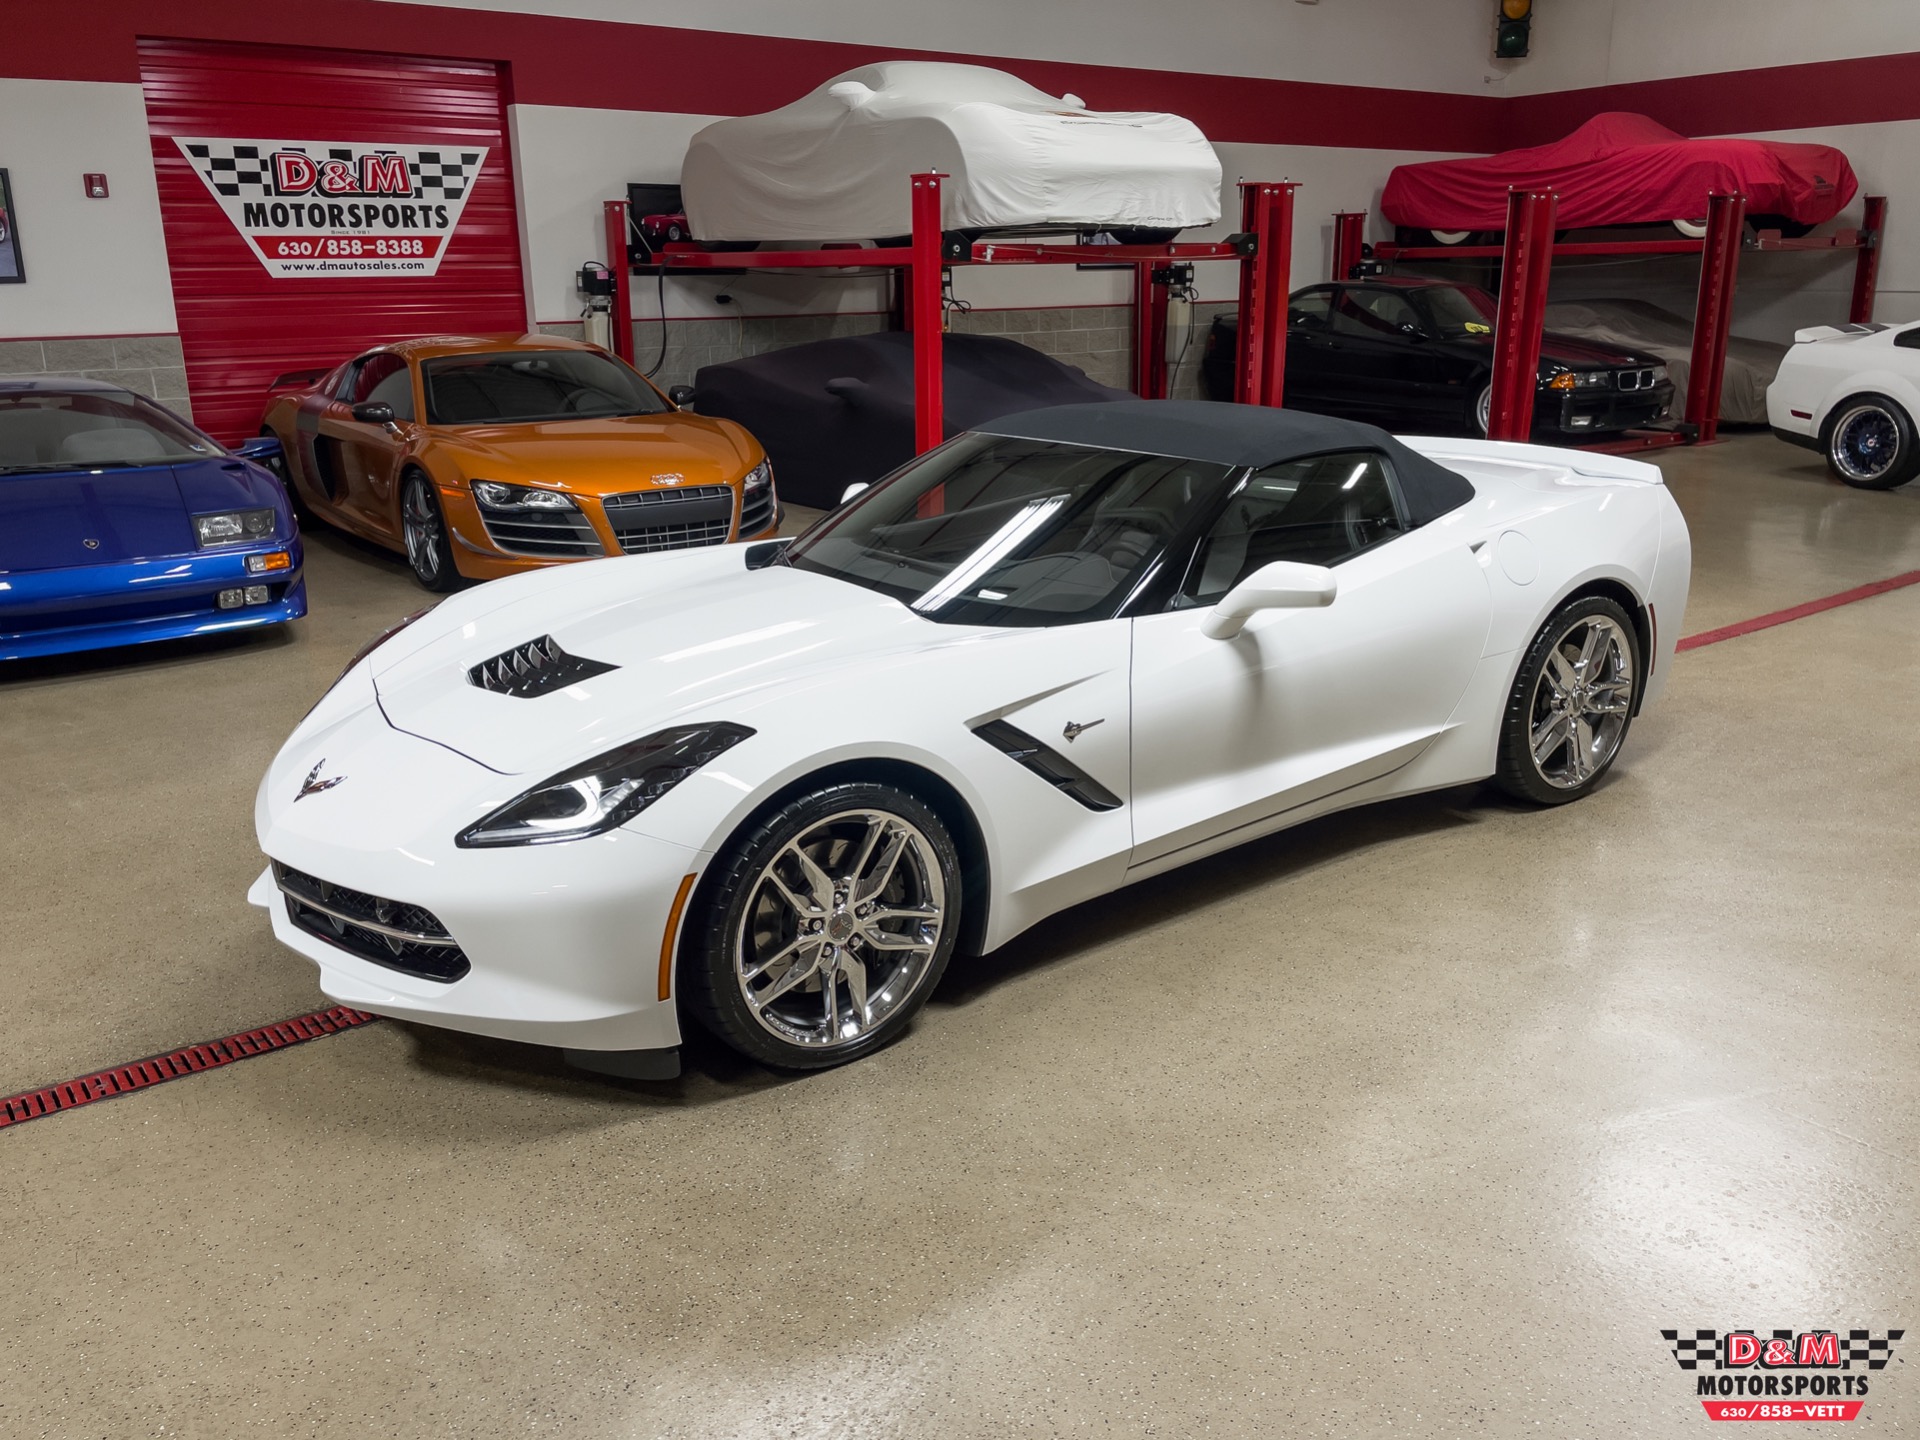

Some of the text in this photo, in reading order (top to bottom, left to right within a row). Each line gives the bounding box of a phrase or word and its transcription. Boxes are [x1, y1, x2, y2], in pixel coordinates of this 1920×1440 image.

[271, 152, 413, 197] D&M
[243, 202, 449, 229] MOTORSPORTS
[281, 261, 425, 271] www.dmautosales.com
